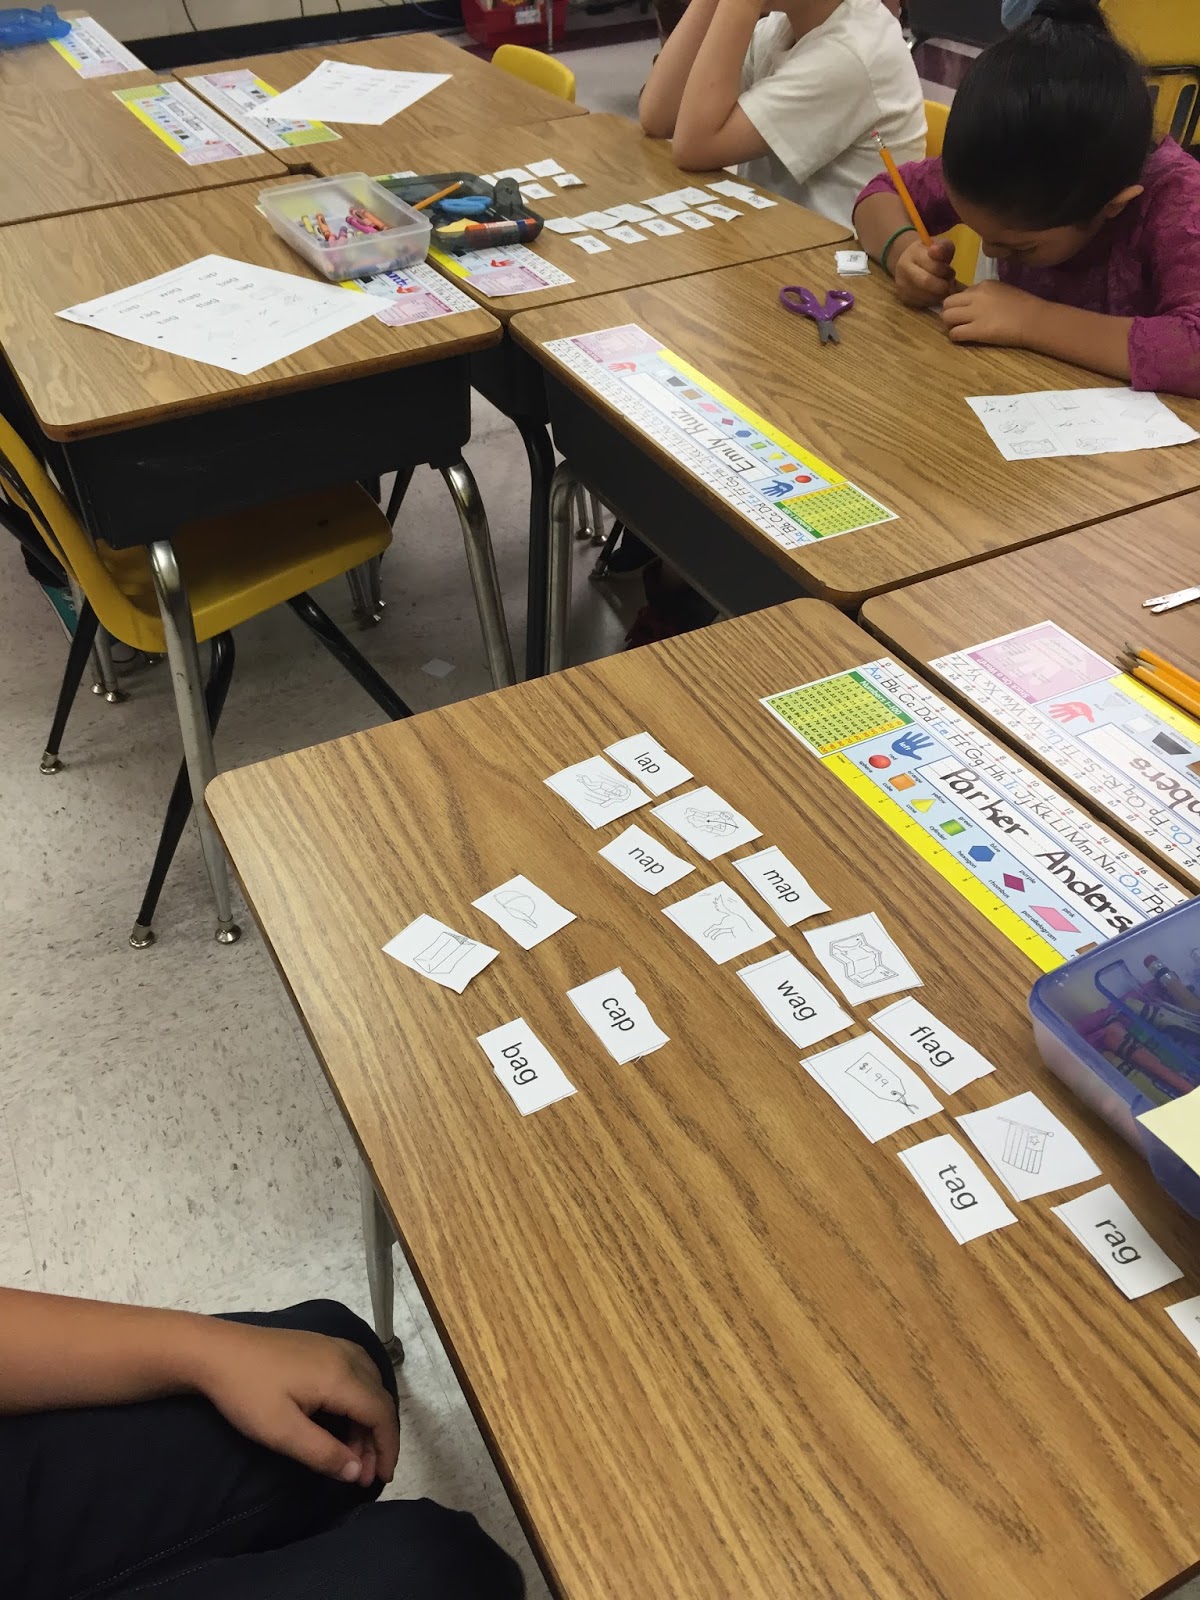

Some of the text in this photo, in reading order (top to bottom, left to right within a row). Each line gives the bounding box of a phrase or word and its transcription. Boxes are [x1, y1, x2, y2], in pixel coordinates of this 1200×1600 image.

[671, 407, 756, 474] Emily Ruiz
[984, 680, 1002, 696] Xx
[1002, 676, 1012, 686] On
[860, 680, 902, 714] Numbers 1-100
[1012, 684, 1030, 699] Stuck
[899, 742, 912, 750] left
[633, 751, 661, 774] lap
[1083, 757, 1102, 774] Ss
[908, 770, 923, 784] orange
[1102, 774, 1123, 790] Rr
[863, 666, 1164, 914] Aa Bb Cc Dd Ee Ff Gg Hh Ii Jj Kk Ll Mm Nn Oo Pp
[882, 782, 894, 792] cube
[1090, 786, 1100, 794] 20
[1124, 784, 1146, 808] Qq
[931, 792, 947, 804] yellow
[906, 804, 917, 814] cone
[1149, 808, 1170, 826] Pp
[958, 816, 974, 828] green
[929, 825, 948, 840] cylinder
[1170, 825, 1192, 845] Oo
[939, 767, 1134, 933] Parker Anders
[990, 842, 1001, 852] blue
[1064, 807, 1074, 815] 12
[1082, 822, 1092, 830] 13
[1118, 851, 1130, 860] 15
[1138, 866, 1148, 875] 16
[1157, 882, 1169, 891] 17
[1164, 844, 1175, 852] 16
[627, 847, 665, 874] nap
[956, 850, 978, 868] hexagon
[1183, 859, 1194, 868] 15
[762, 869, 800, 903] map
[1018, 870, 1037, 884] purple
[988, 879, 1010, 898] rhombus
[1062, 908, 1076, 918] pink
[1020, 910, 1058, 942] parallelogram
[776, 979, 818, 1022] wag
[601, 997, 636, 1032] cap
[909, 1026, 955, 1068] flag
[500, 1041, 539, 1086] bag
[938, 1163, 979, 1211] tag
[1095, 1219, 1142, 1265] rag
